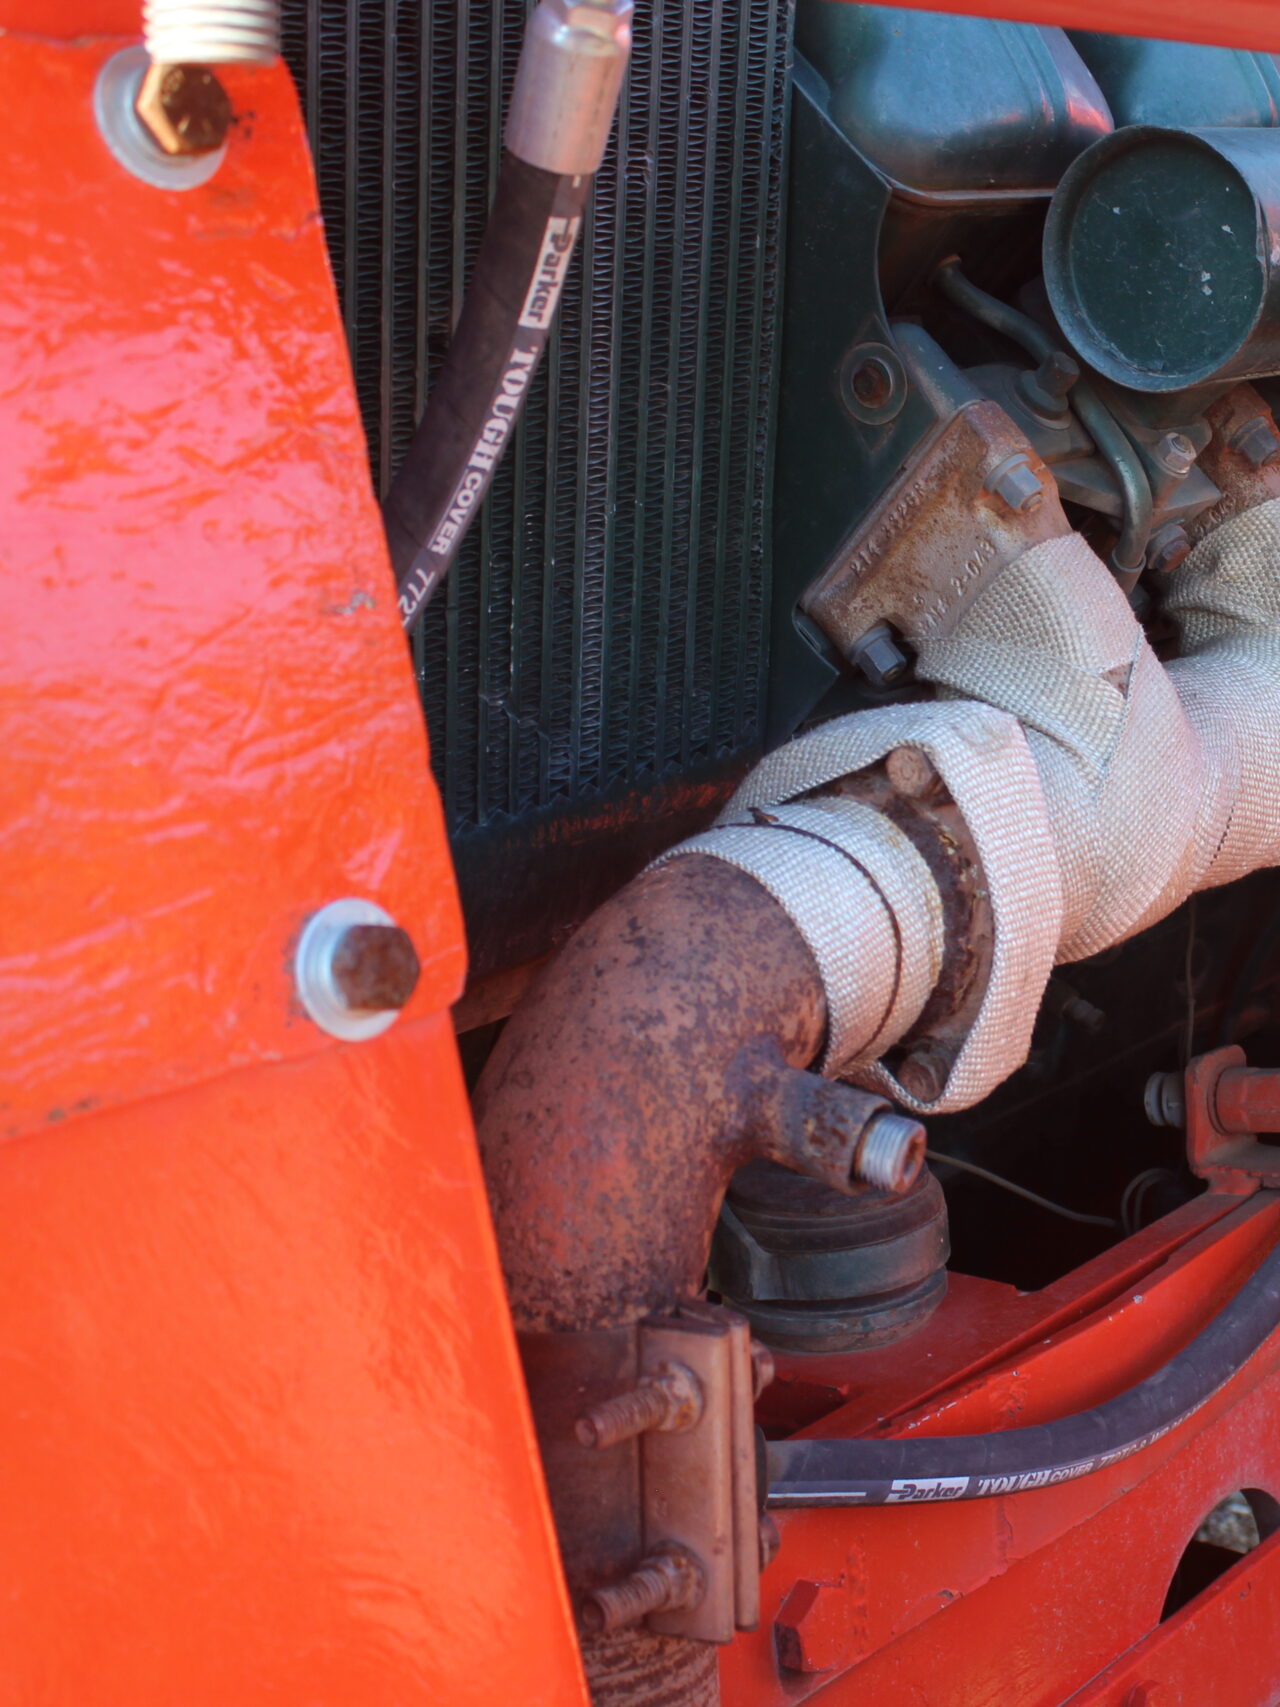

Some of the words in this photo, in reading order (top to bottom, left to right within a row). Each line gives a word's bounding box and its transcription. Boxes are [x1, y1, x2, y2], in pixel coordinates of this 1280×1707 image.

[526, 217, 574, 323] Parker
[467, 346, 539, 473] TOUGH
[430, 471, 484, 556] COVER
[889, 1482, 964, 1500] Parker
[976, 1470, 1052, 1496] TOUGH
[1048, 1462, 1094, 1482] COVER
